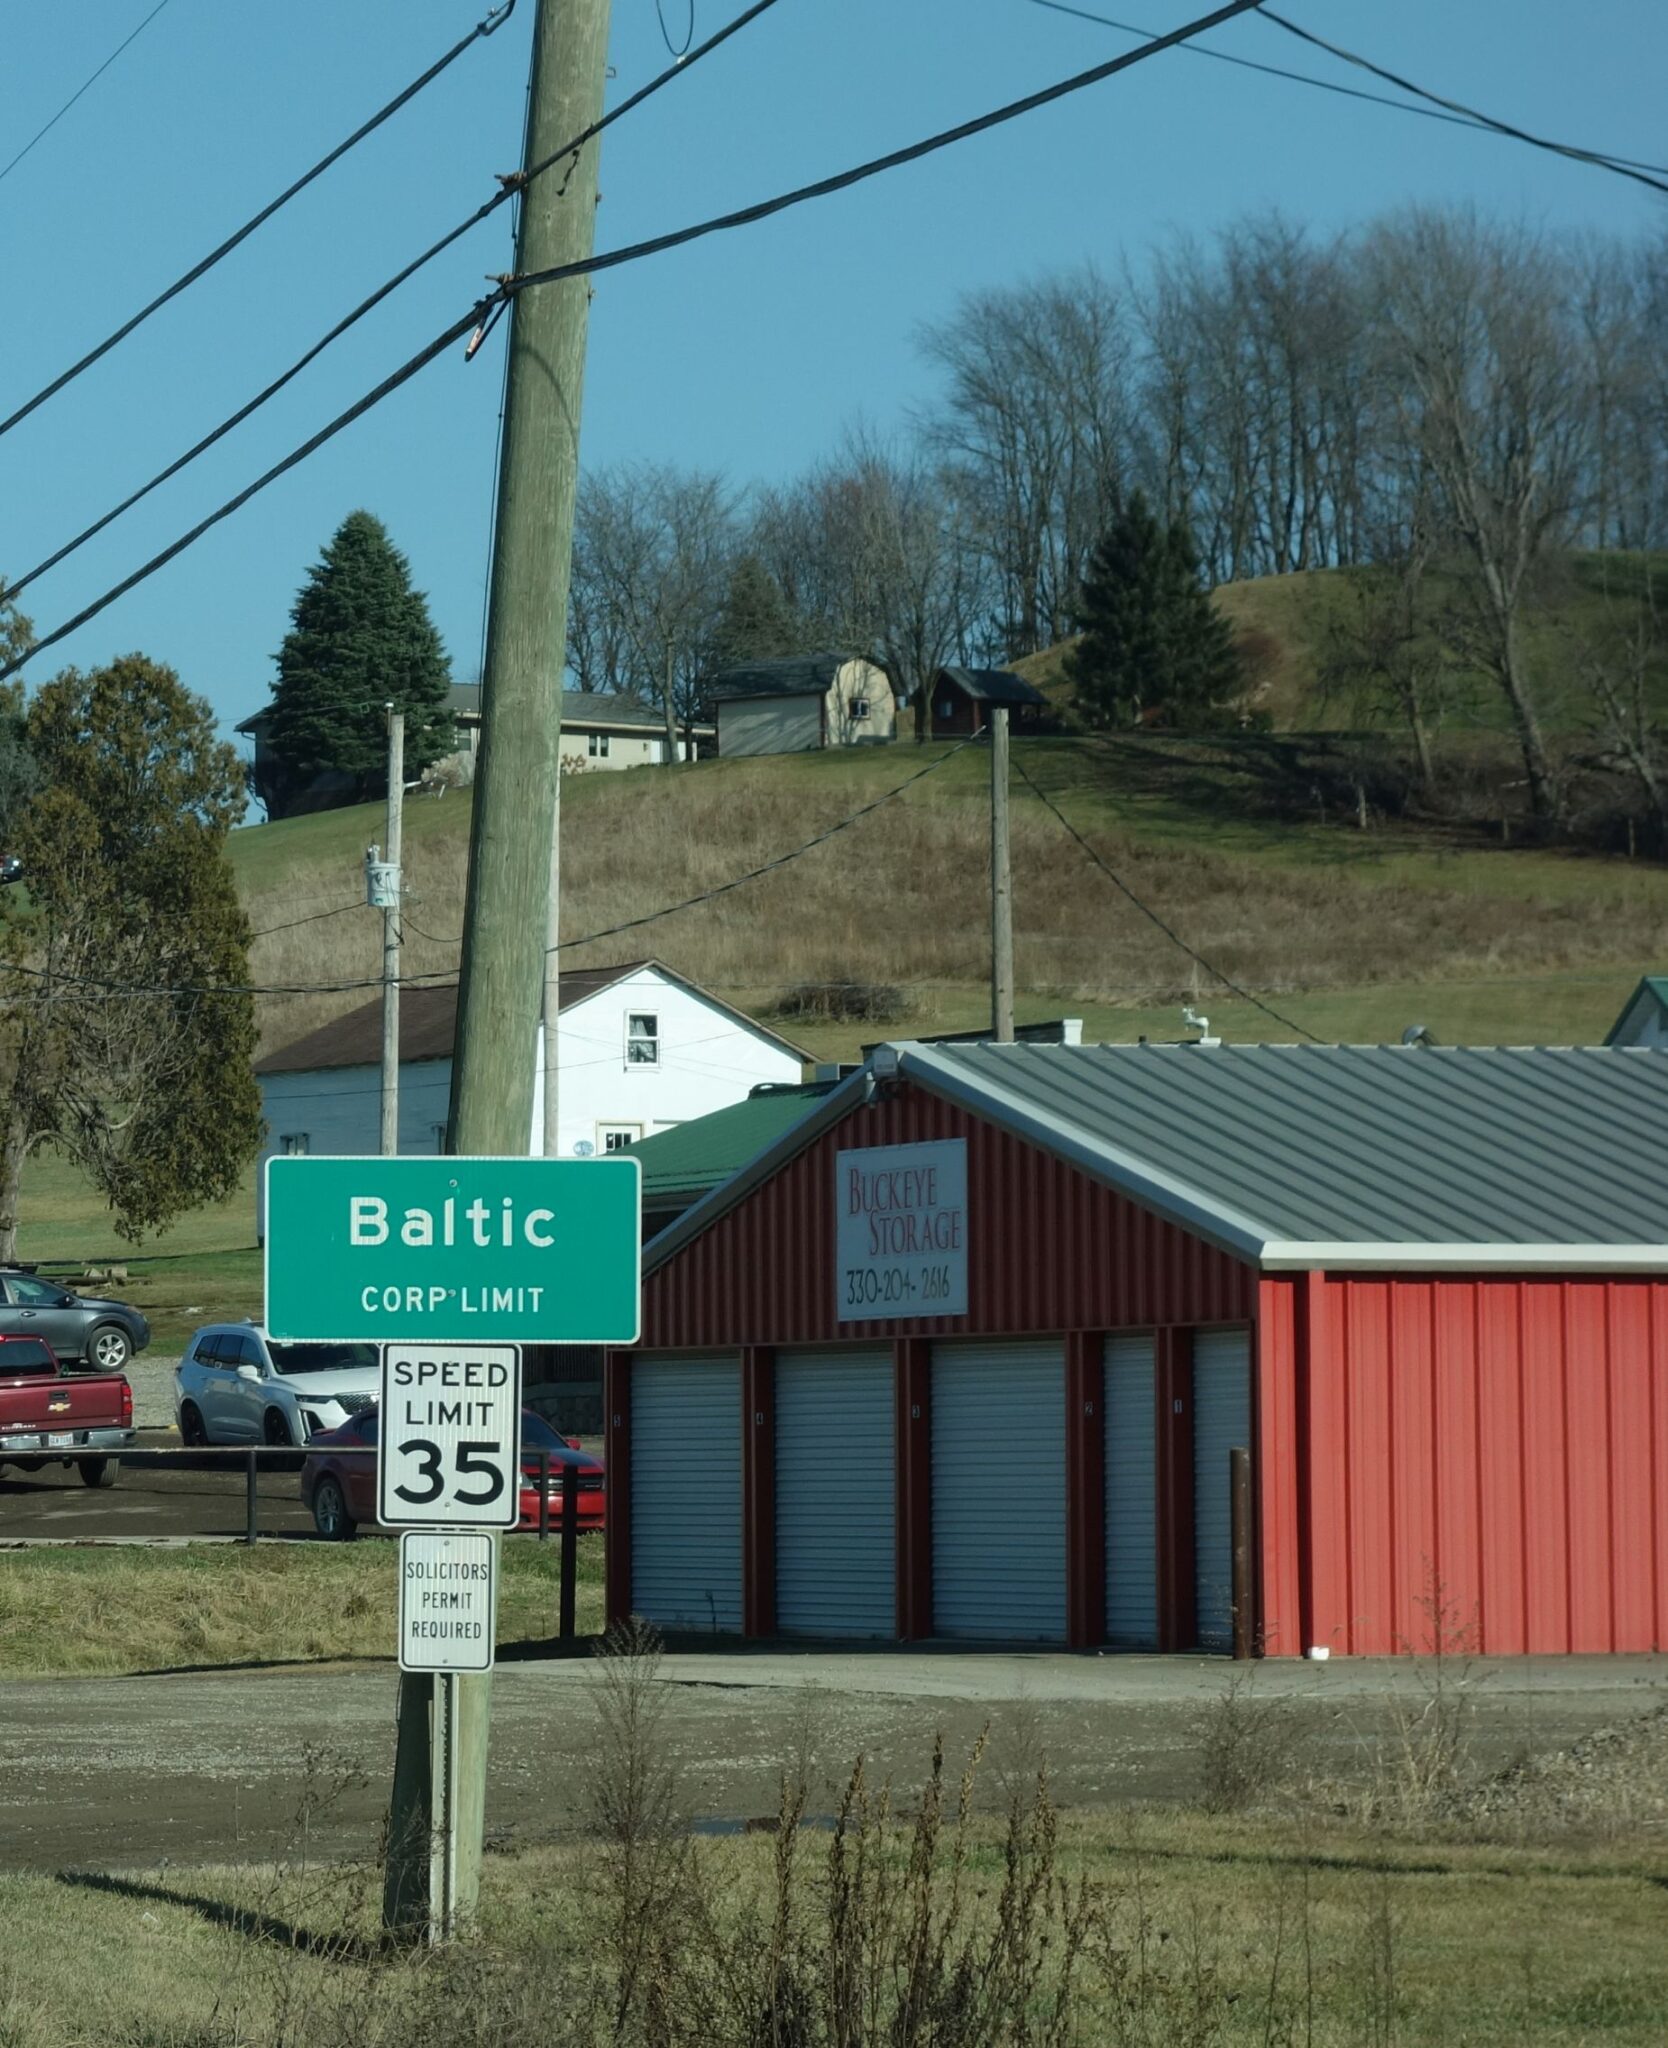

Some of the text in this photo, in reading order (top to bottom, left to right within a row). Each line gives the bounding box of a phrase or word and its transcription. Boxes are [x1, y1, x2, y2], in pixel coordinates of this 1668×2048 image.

[849, 1167, 936, 1215] BUCKEYE
[350, 1196, 556, 1248] Baltic
[869, 1210, 961, 1256] STORAGE
[361, 1286, 544, 1313] CORP LIMIT
[394, 1360, 508, 1388] SPEED
[406, 1400, 494, 1426] LIMIT
[393, 1438, 505, 1506] 35
[406, 1561, 488, 1581] SOLICITORS
[422, 1591, 473, 1610] PERMIT
[411, 1620, 482, 1640] REQUIRED
